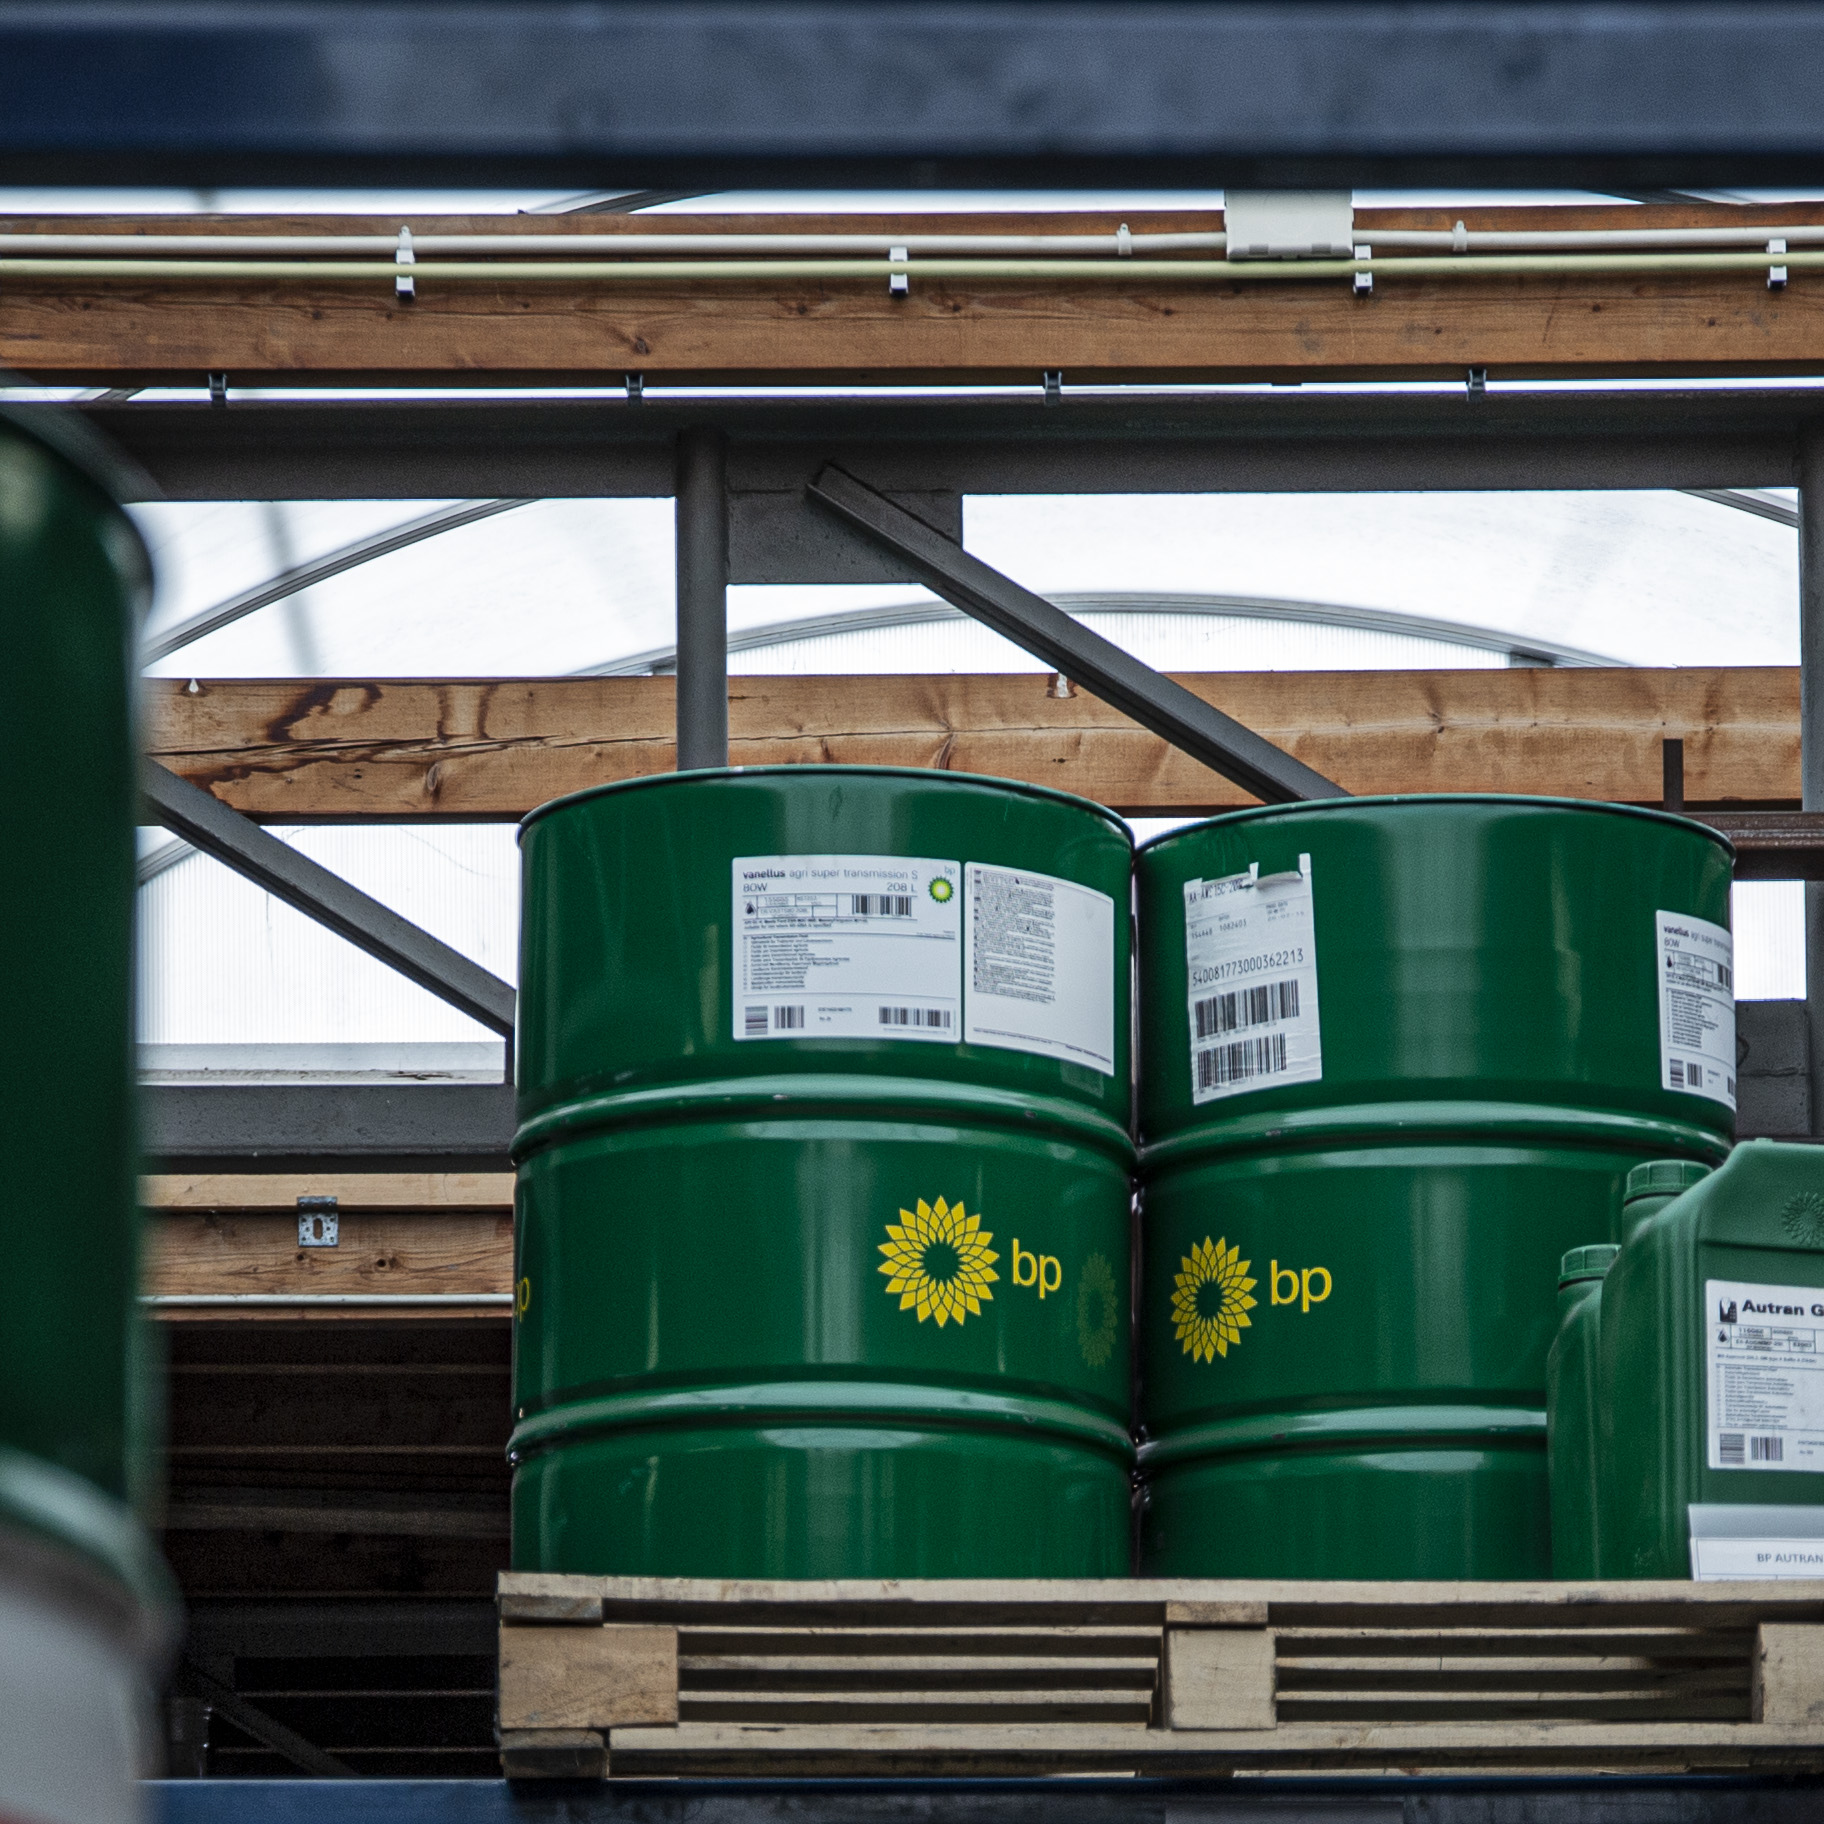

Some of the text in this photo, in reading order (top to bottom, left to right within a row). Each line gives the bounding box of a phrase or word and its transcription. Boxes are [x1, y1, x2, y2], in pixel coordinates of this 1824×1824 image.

[743, 869, 786, 880] vanellus
[789, 868, 809, 881] agri
[811, 868, 840, 881] super
[843, 868, 908, 880] transmission
[743, 882, 767, 892] 80W
[887, 882, 907, 892] 208
[1192, 947, 1304, 987] 540081773000362213
[1011, 1239, 1062, 1299] bp
[1269, 1258, 1333, 1313] bp
[1742, 1299, 1804, 1316] Autran
[1757, 1552, 1772, 1564] BP
[1775, 1553, 1824, 1565] AUTRAN
